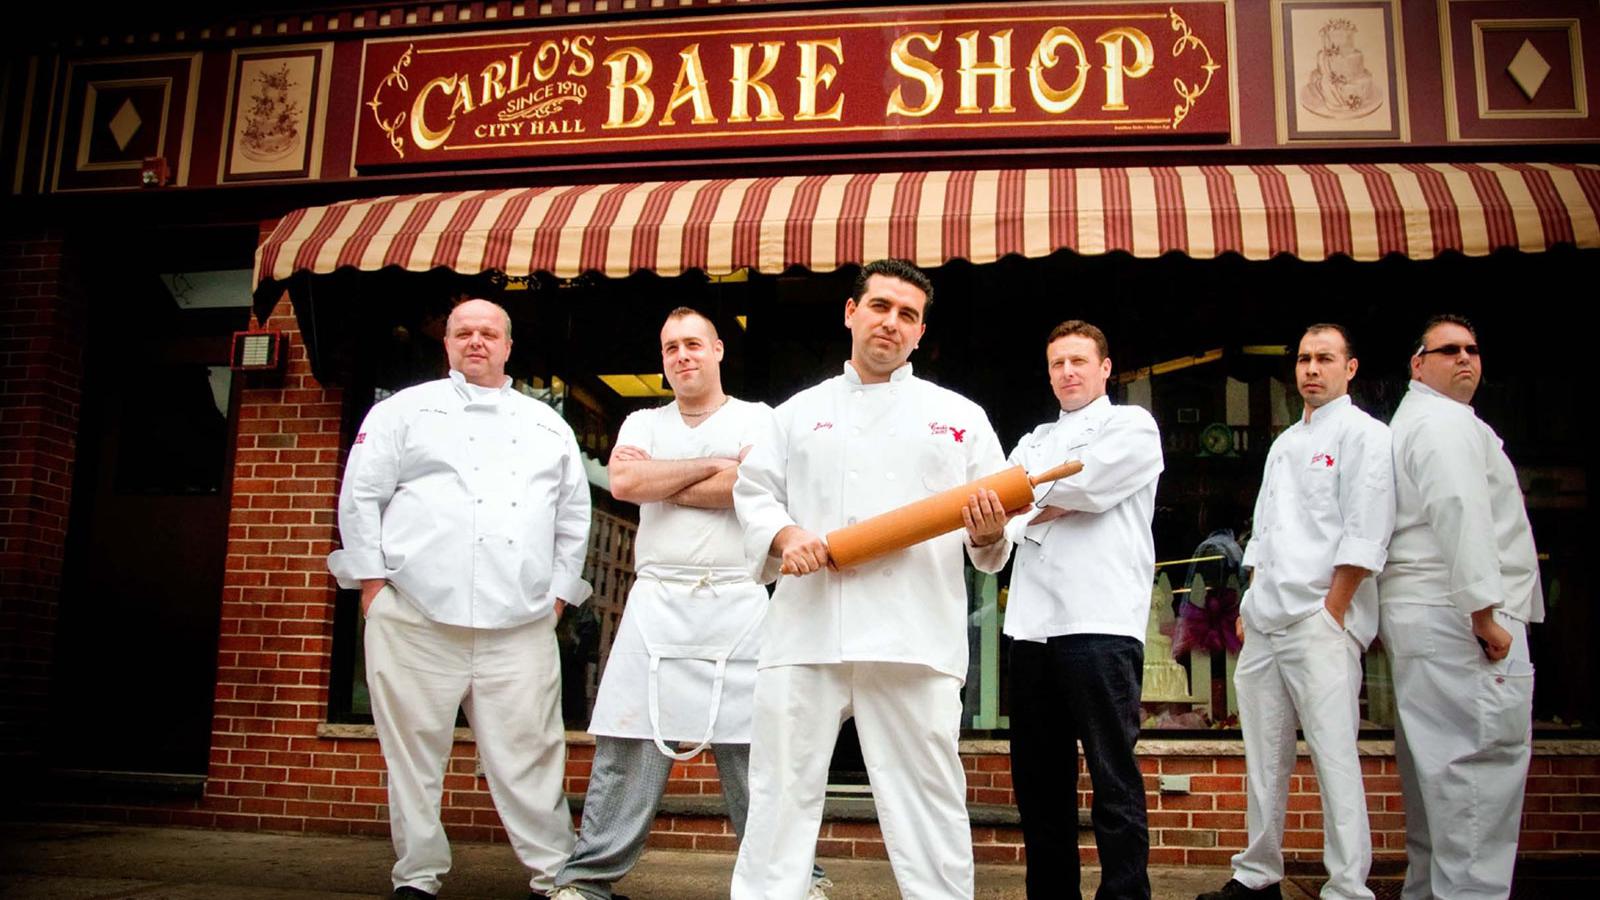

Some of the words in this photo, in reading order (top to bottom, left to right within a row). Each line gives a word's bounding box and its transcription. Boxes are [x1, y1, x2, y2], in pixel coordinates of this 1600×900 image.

[411, 35, 596, 150] CARLO'S
[601, 37, 845, 129] BAKE
[886, 26, 1155, 117] SHOP
[506, 83, 554, 114] SINCE
[556, 80, 588, 99] 1910
[474, 121, 524, 138] CITY
[530, 119, 586, 135] HALL
